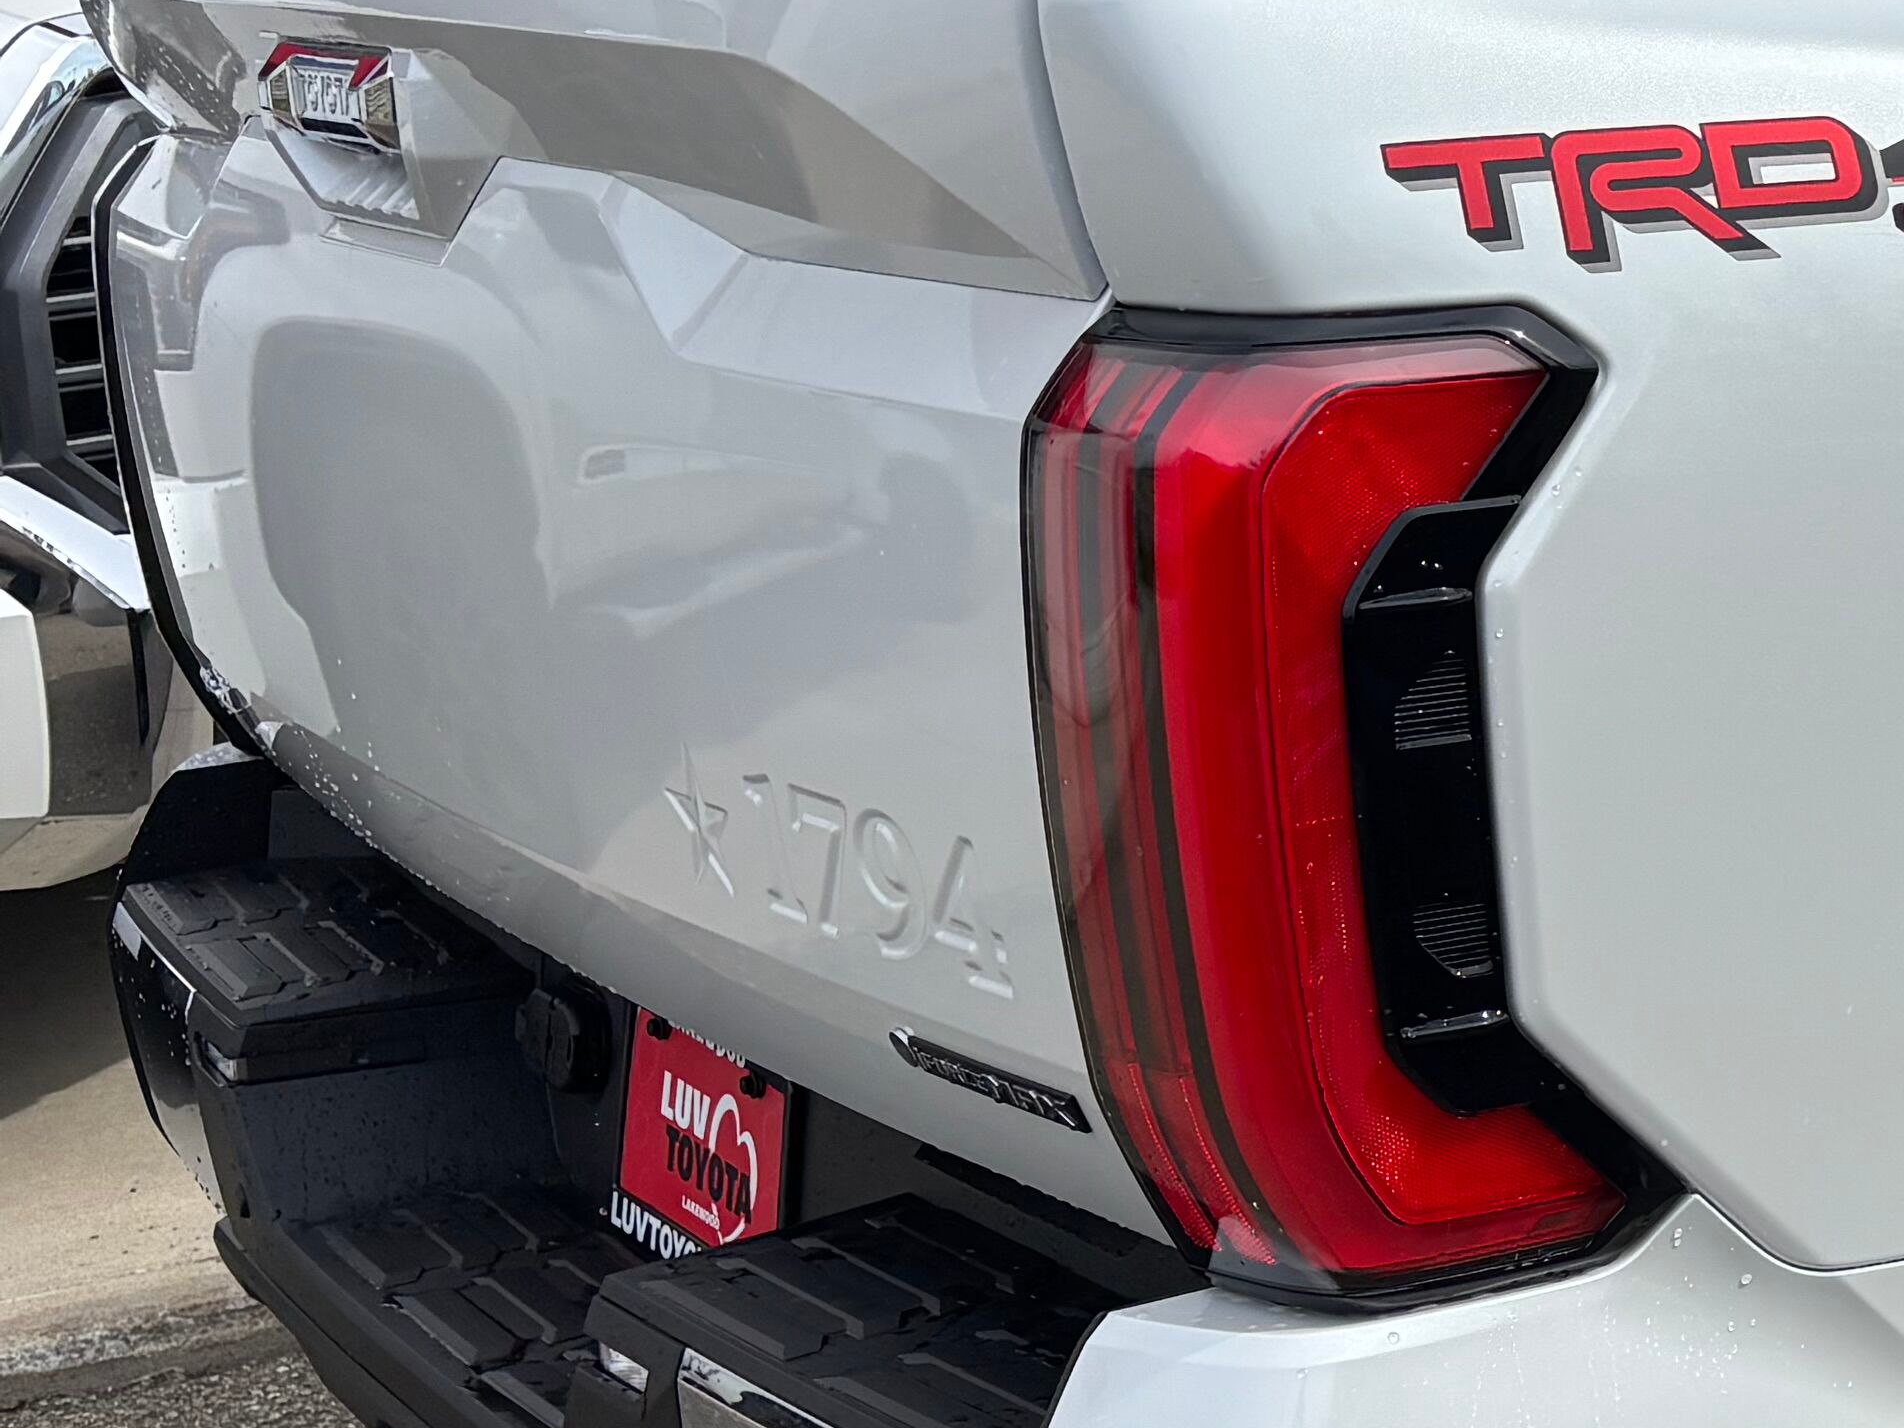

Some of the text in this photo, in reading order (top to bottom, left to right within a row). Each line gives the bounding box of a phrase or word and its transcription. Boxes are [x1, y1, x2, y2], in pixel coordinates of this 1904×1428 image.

[1382, 114, 1884, 270] TRD
[742, 772, 1014, 1000] 1794
[660, 1069, 712, 1140] LUV
[665, 1123, 753, 1226] TOYOTA
